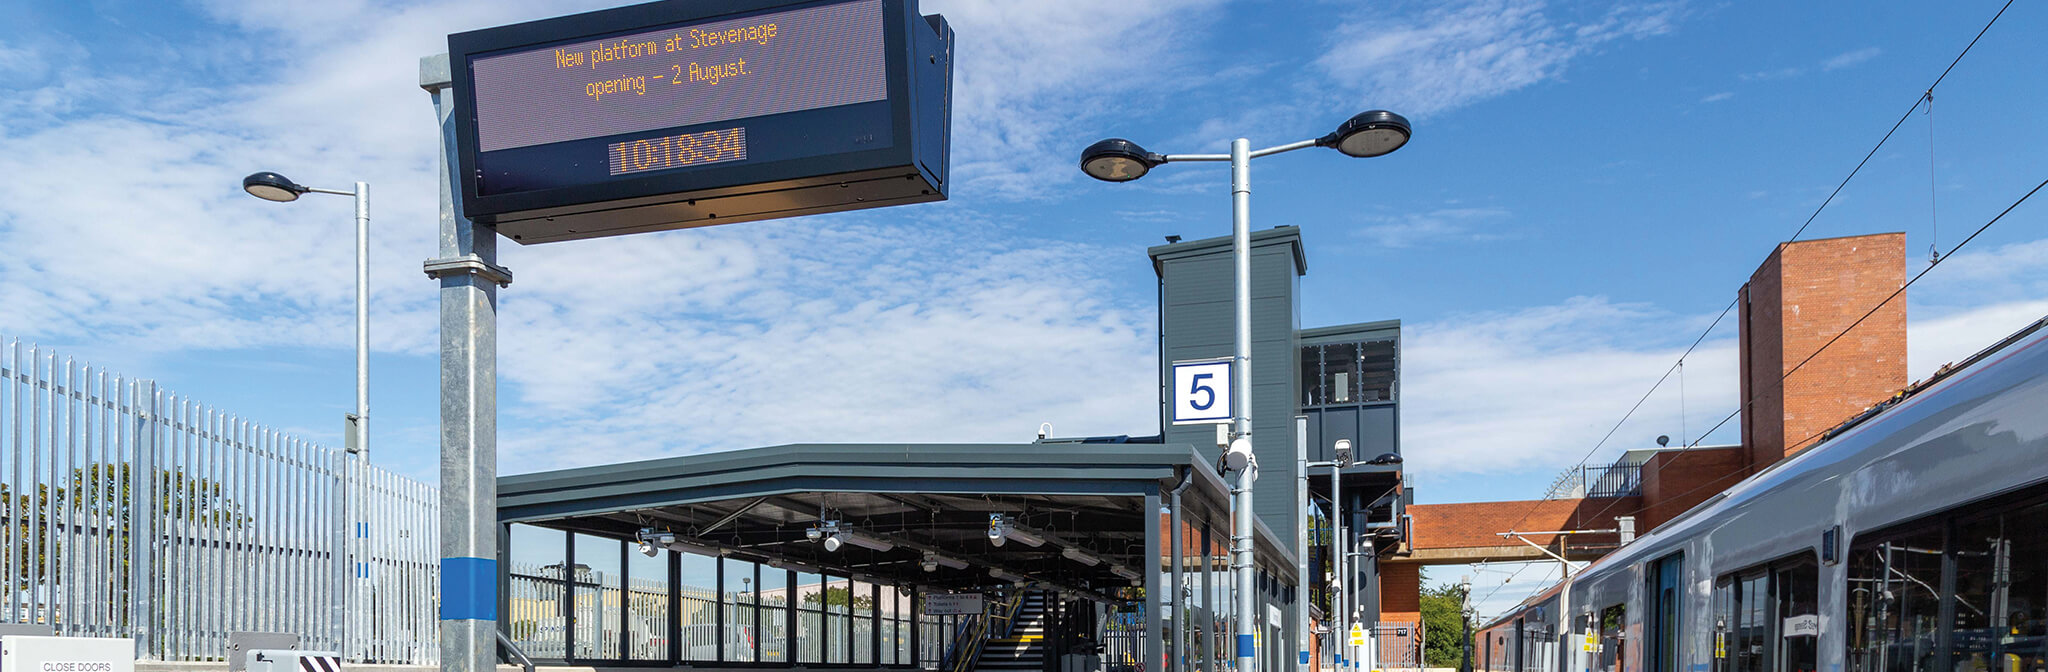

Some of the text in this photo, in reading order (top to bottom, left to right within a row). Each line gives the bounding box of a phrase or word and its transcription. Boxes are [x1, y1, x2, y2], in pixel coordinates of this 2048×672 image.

[555, 23, 778, 69] New platform at Stevenage
[586, 74, 646, 101] opening
[671, 64, 682, 84] 2
[689, 58, 752, 85] August.
[615, 127, 742, 172] 10:18:34
[1190, 373, 1215, 411] 5
[43, 662, 111, 672] CLOSE DOORS
